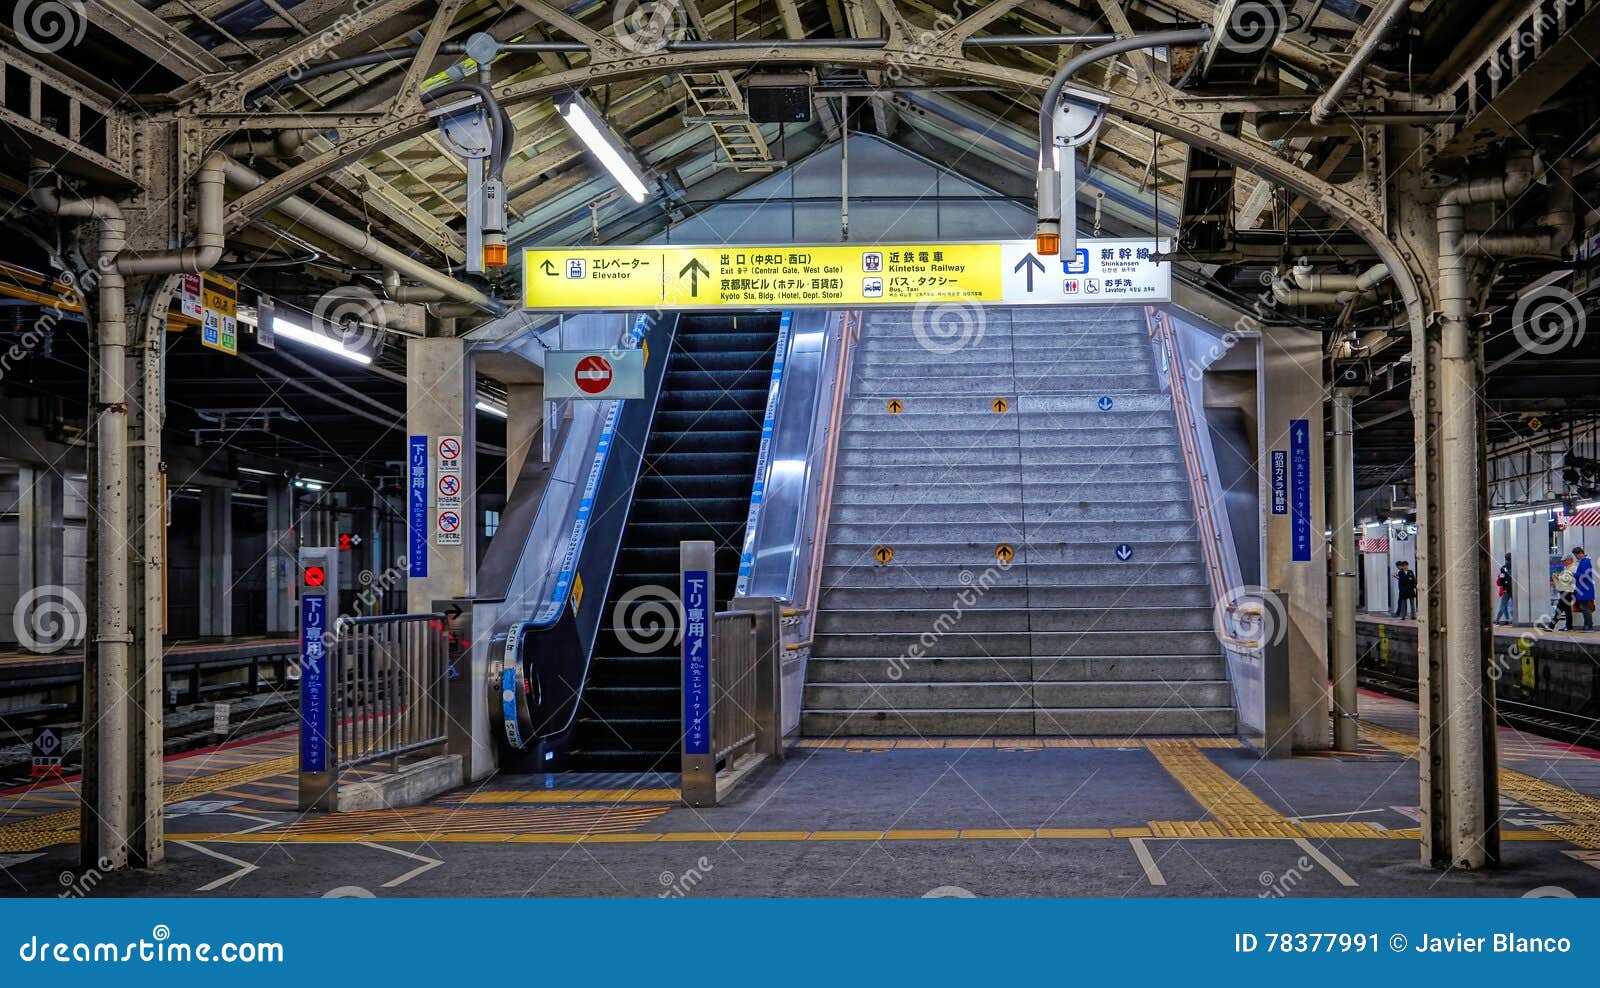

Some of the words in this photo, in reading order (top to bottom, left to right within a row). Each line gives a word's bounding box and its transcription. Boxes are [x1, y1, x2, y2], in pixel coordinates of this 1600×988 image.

[889, 251, 944, 263] 近鉄電車
[1101, 247, 1150, 260] 新幹線
[593, 258, 650, 269] エレベーター
[720, 254, 746, 266] 出口
[720, 267, 734, 275] Exit
[803, 266, 821, 274] West
[823, 265, 844, 274] Gate)
[889, 265, 926, 273] Kintetsu
[931, 264, 965, 273] Railway
[592, 271, 631, 279] Elevator
[720, 279, 770, 291] 京都駅ビル
[1105, 279, 1132, 287] お手洗
[758, 292, 776, 301] Bldg.
[821, 291, 843, 300] Store)
[412, 443, 425, 489] 下り専用
[688, 579, 705, 637] 下り専用
[306, 598, 322, 656] 下り専用
[40, 735, 54, 748] 10
